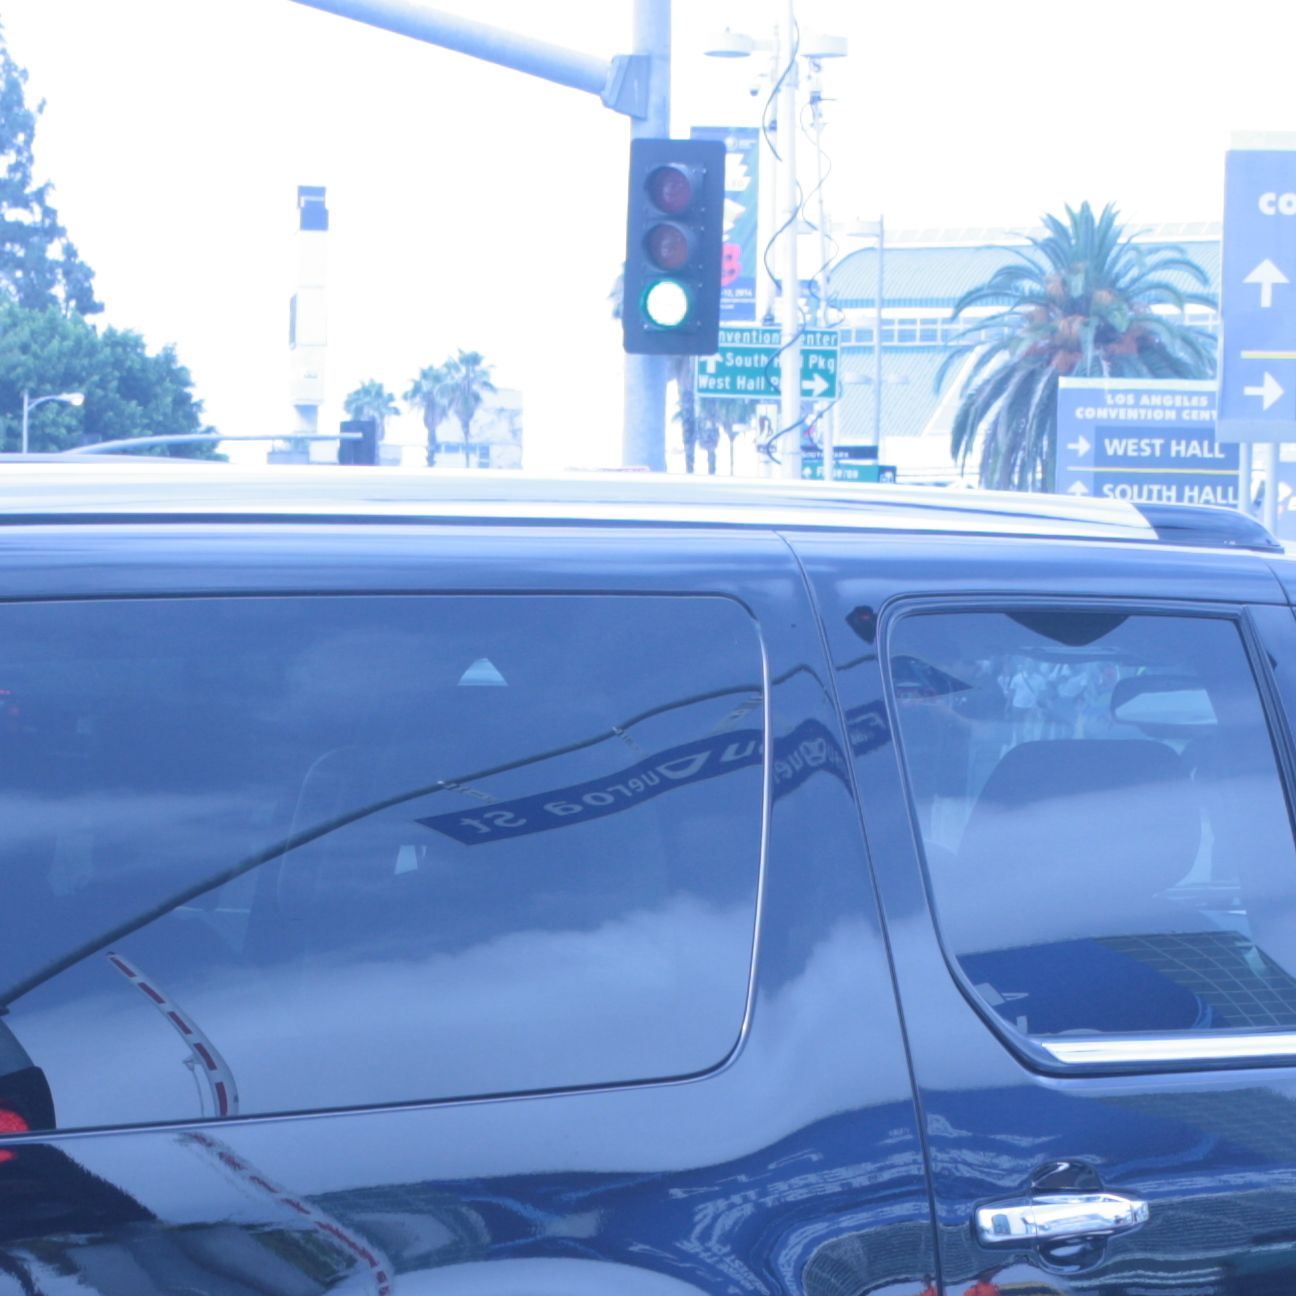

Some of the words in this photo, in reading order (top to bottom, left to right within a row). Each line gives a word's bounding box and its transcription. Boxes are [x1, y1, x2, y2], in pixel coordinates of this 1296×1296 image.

[719, 330, 781, 345] nvention
[799, 334, 837, 347] enter
[725, 352, 768, 367] South
[809, 354, 836, 373] Pkg
[698, 374, 731, 390] West
[736, 375, 765, 391] Hall
[1105, 393, 1135, 406] LOS
[1140, 394, 1209, 407] ANGELES
[1075, 407, 1177, 421] CONVENTION
[1182, 408, 1217, 421] CENT
[1104, 438, 1165, 457] WEST
[1170, 440, 1226, 459] HALL
[1102, 483, 1178, 504] SOUTH
[1184, 485, 1240, 505] HALL
